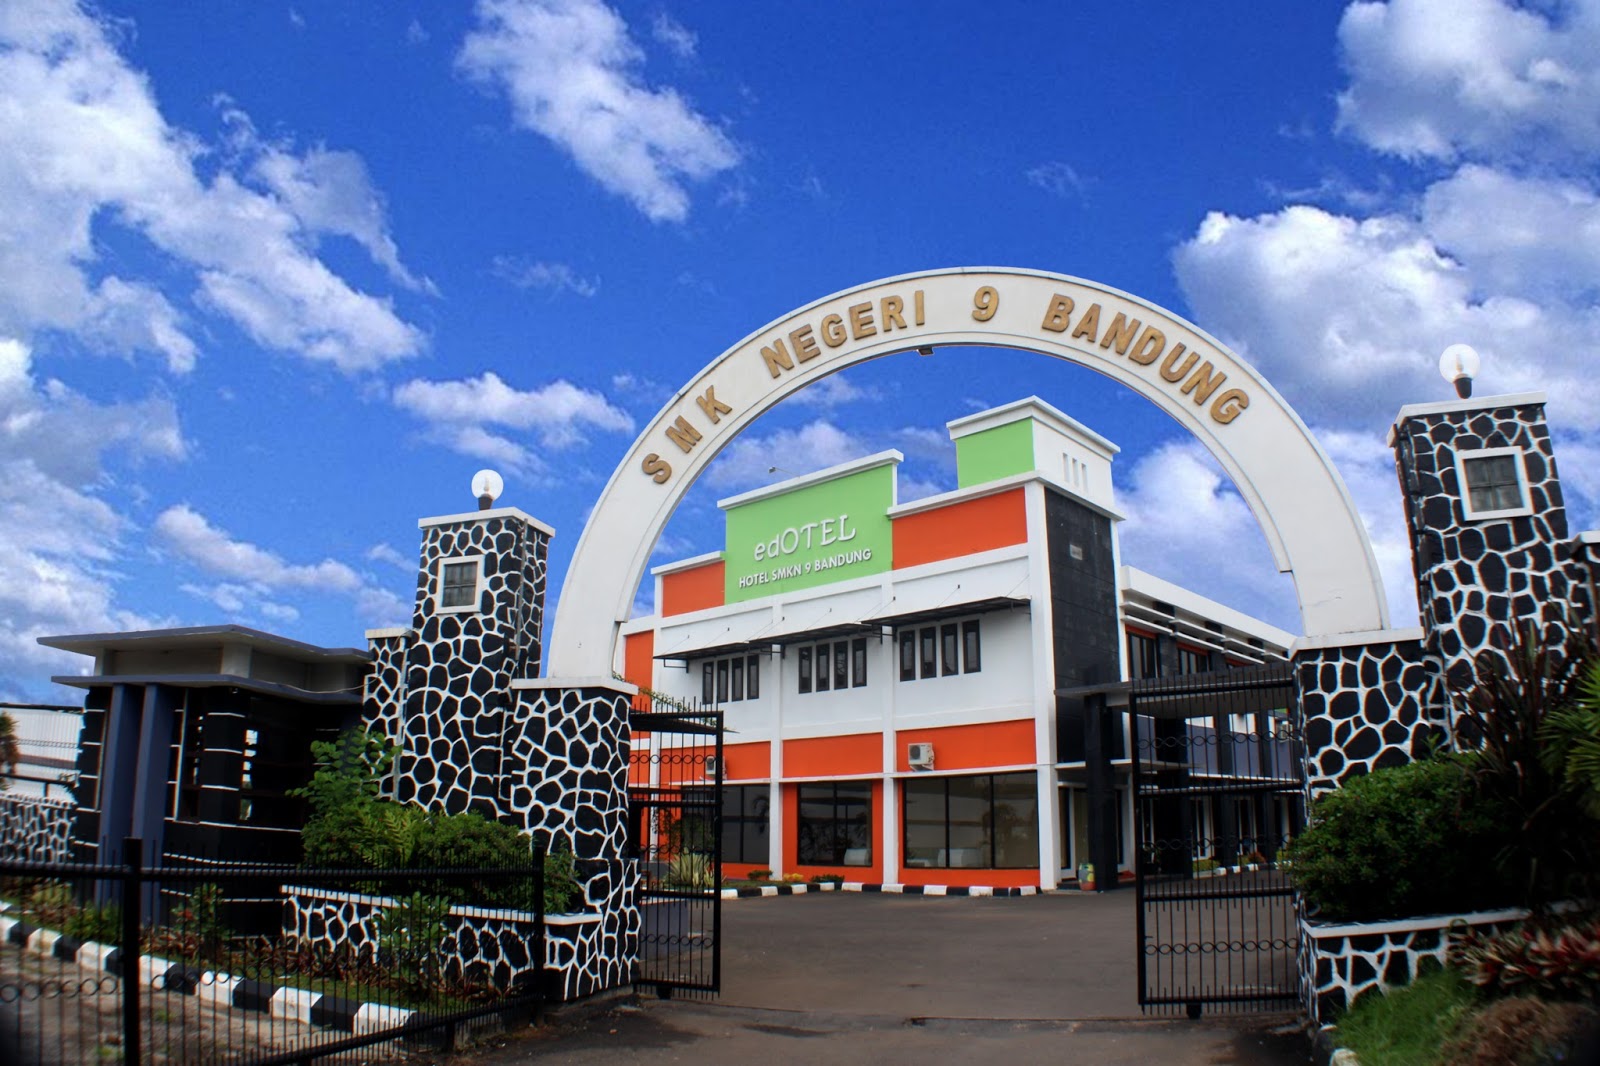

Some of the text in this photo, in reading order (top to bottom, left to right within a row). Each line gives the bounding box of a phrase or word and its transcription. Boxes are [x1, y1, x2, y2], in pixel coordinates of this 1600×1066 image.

[642, 285, 1249, 484] SMK NEGERI 9 BANDUNG
[739, 548, 873, 588] HOTEL SMKN 9 BANDUNG
